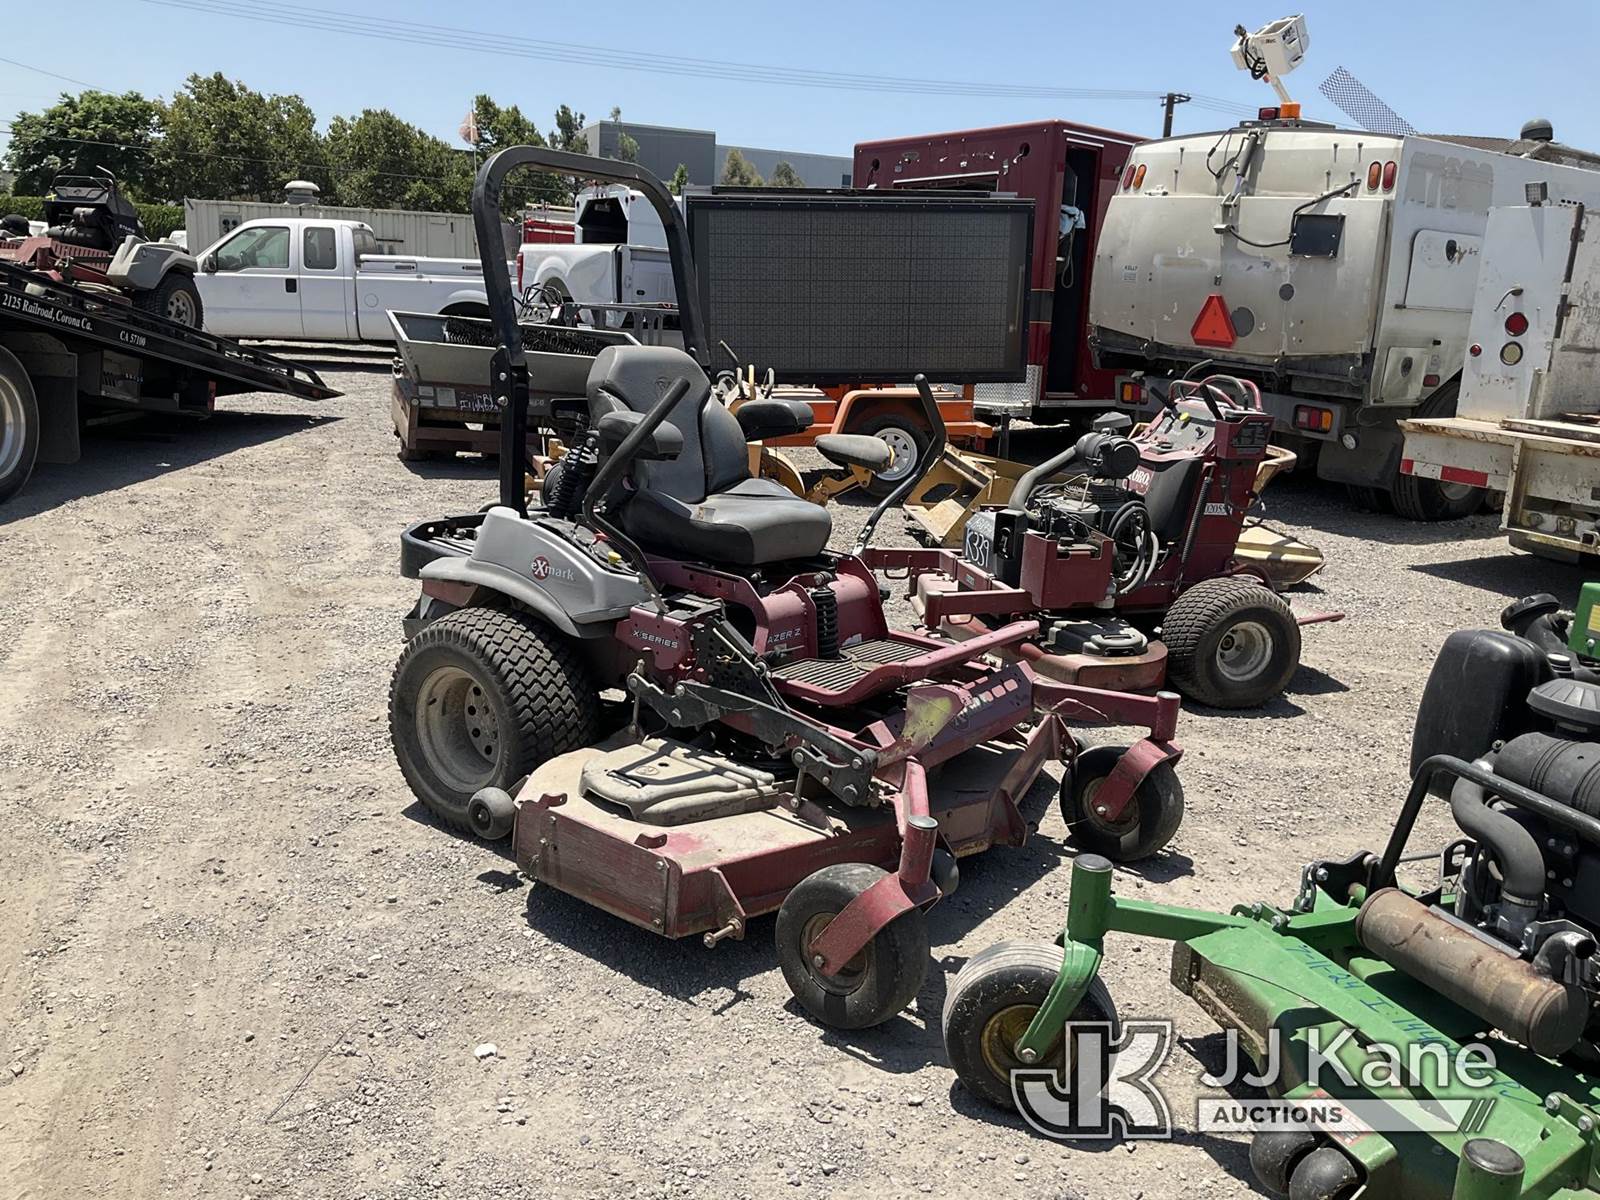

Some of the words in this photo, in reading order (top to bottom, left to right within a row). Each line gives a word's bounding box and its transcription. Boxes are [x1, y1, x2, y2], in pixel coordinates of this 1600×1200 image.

[2, 293, 22, 309] 2125
[22, 299, 55, 322] Railroad,
[56, 309, 81, 327] Corona
[120, 330, 129, 342] CA
[767, 630, 793, 644] AZER
